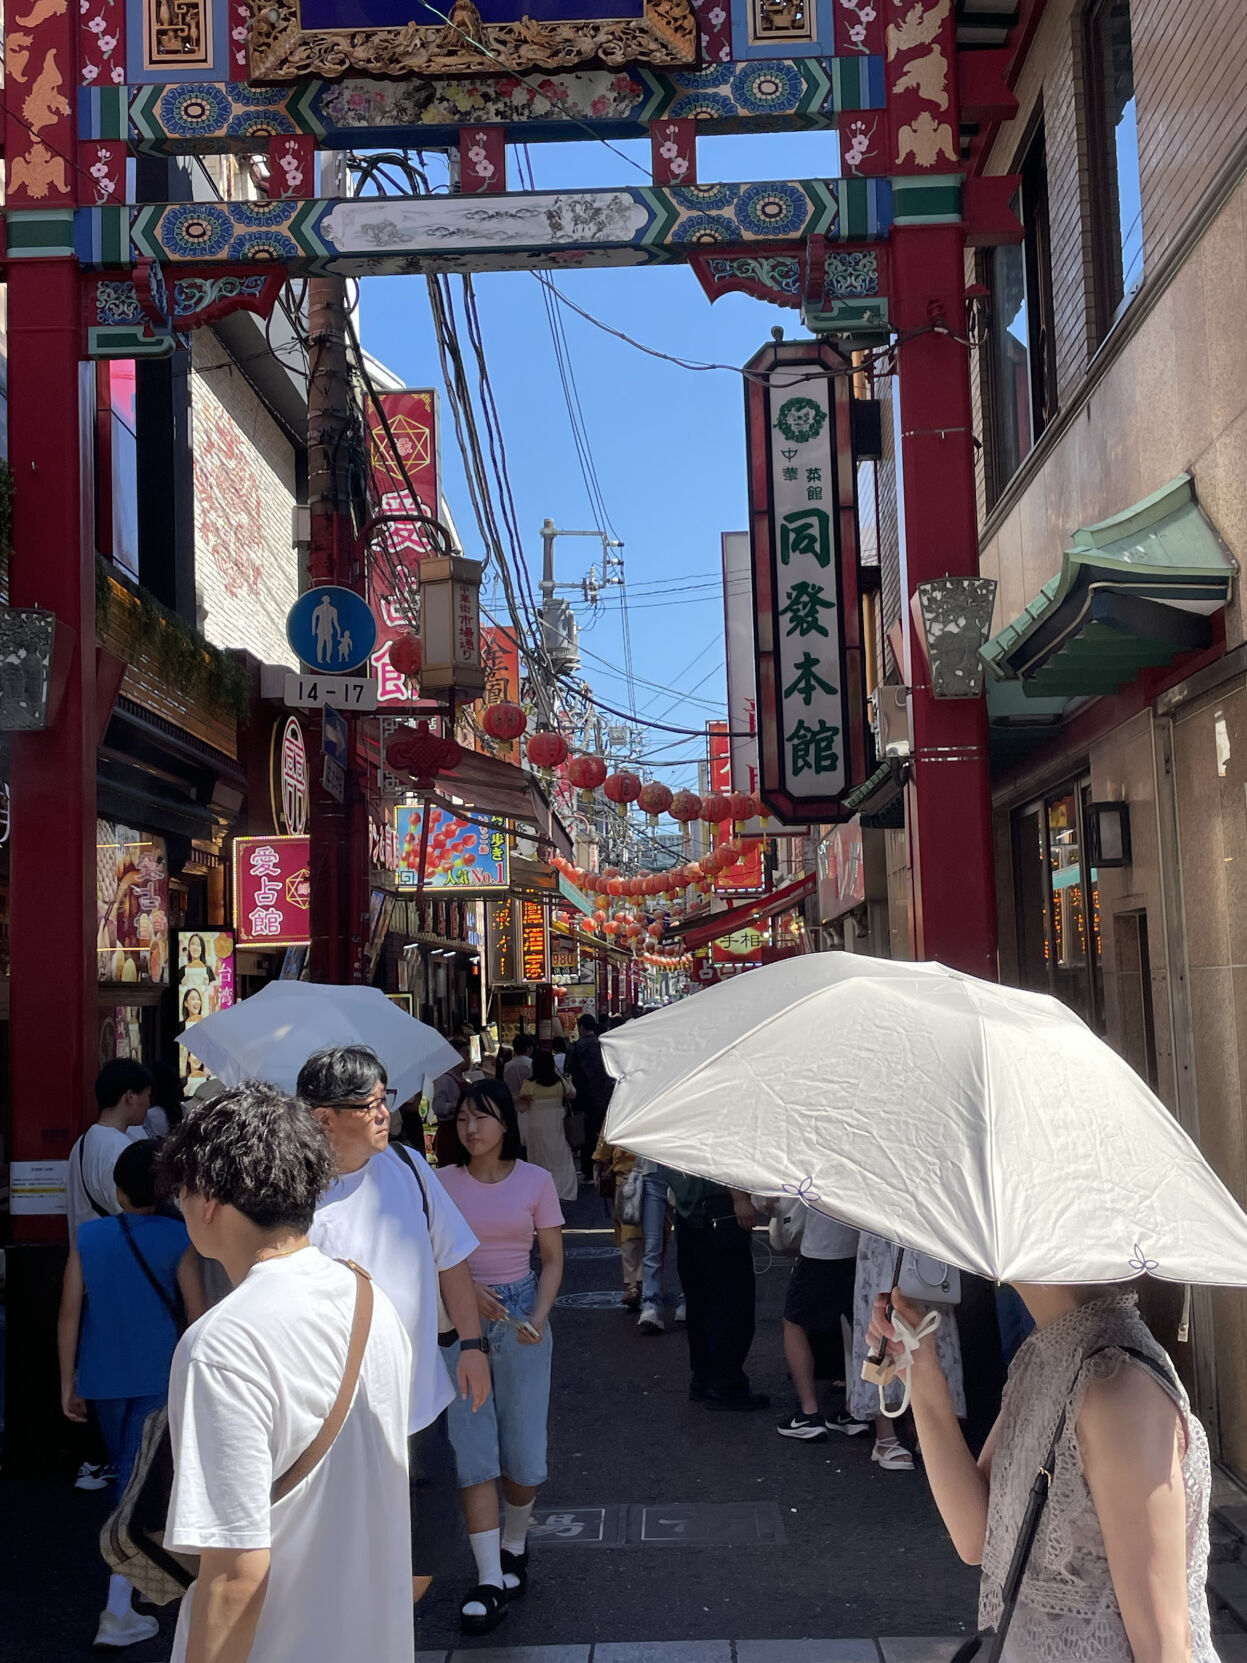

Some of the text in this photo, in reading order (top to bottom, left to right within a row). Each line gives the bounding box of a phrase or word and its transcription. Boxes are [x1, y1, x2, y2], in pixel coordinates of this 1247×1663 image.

[781, 447, 798, 482] 中華
[805, 467, 823, 501] 菜館
[458, 584, 475, 660] 中華街市場通り
[779, 507, 839, 777] 同發本館
[298, 681, 364, 703] 14-17
[249, 846, 283, 936] 愛占館
[719, 932, 765, 949] 手相
